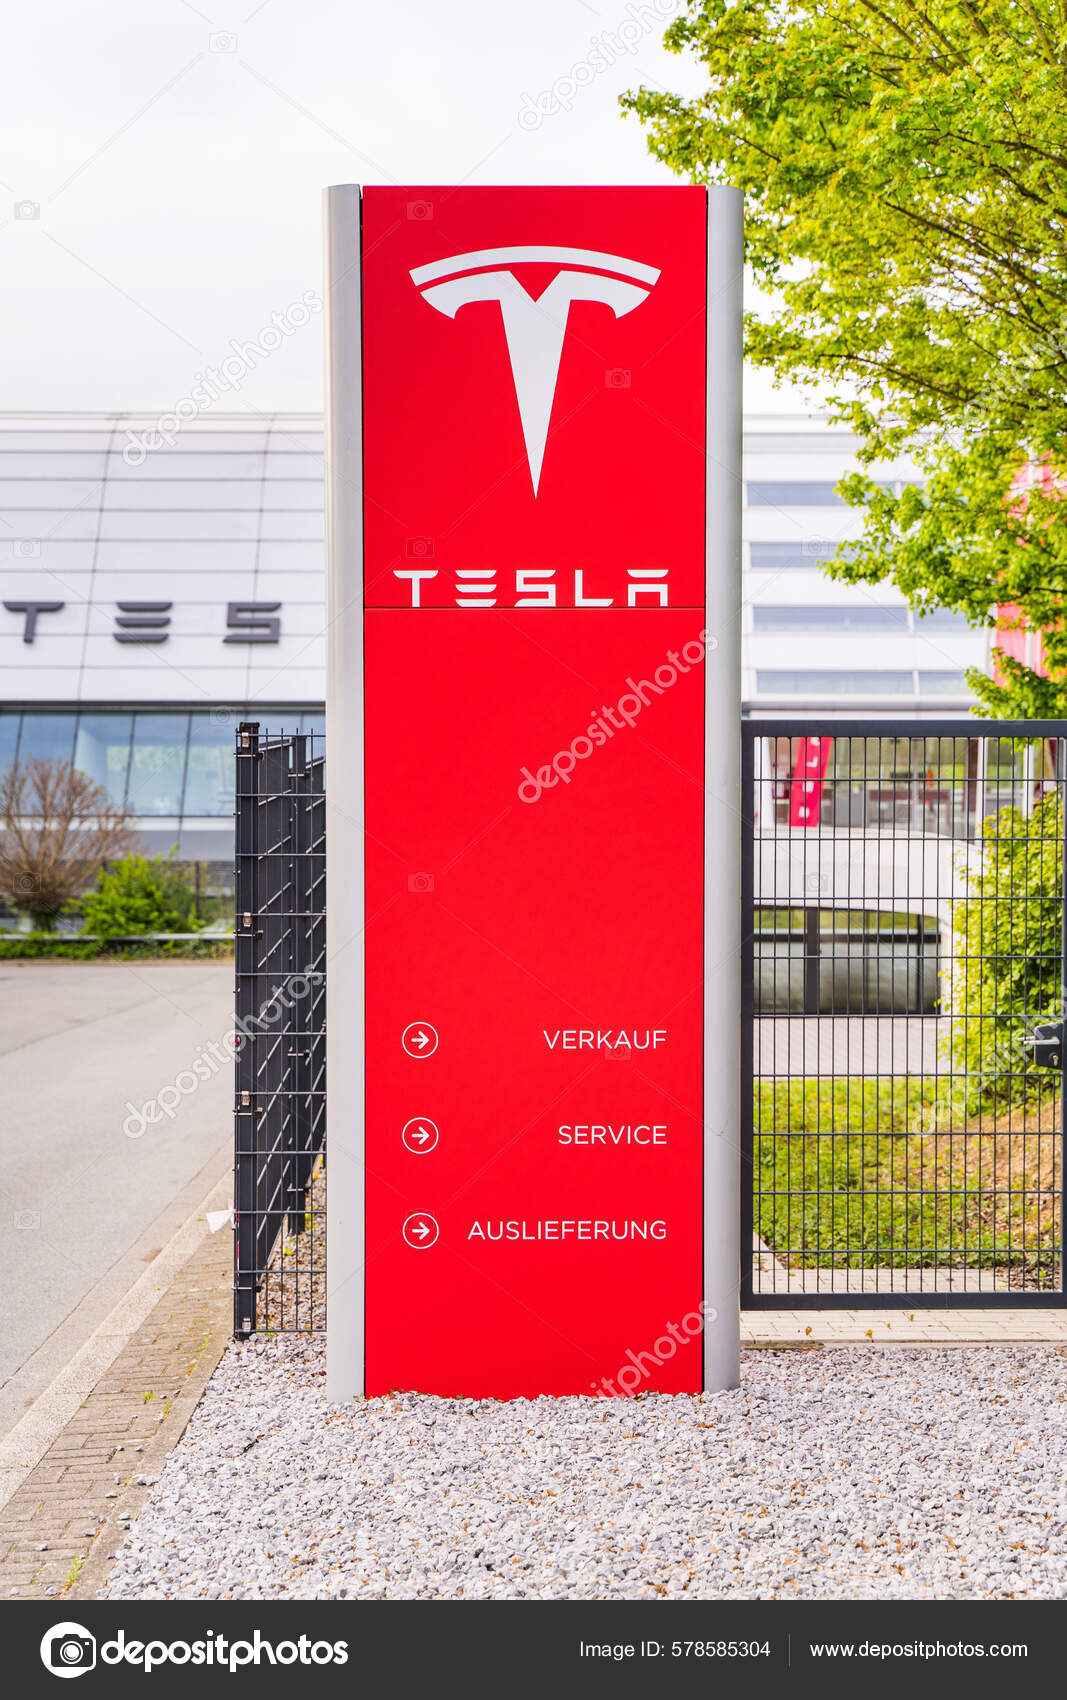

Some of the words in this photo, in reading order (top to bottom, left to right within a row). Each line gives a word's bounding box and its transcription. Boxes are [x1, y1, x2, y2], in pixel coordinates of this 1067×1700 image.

[392, 569, 669, 607] TESLA
[4, 602, 282, 643] TES
[543, 1029, 667, 1050] VERKAUF
[557, 1125, 667, 1145] SERVICE
[467, 1220, 667, 1240] AUSLIEFERUNG
